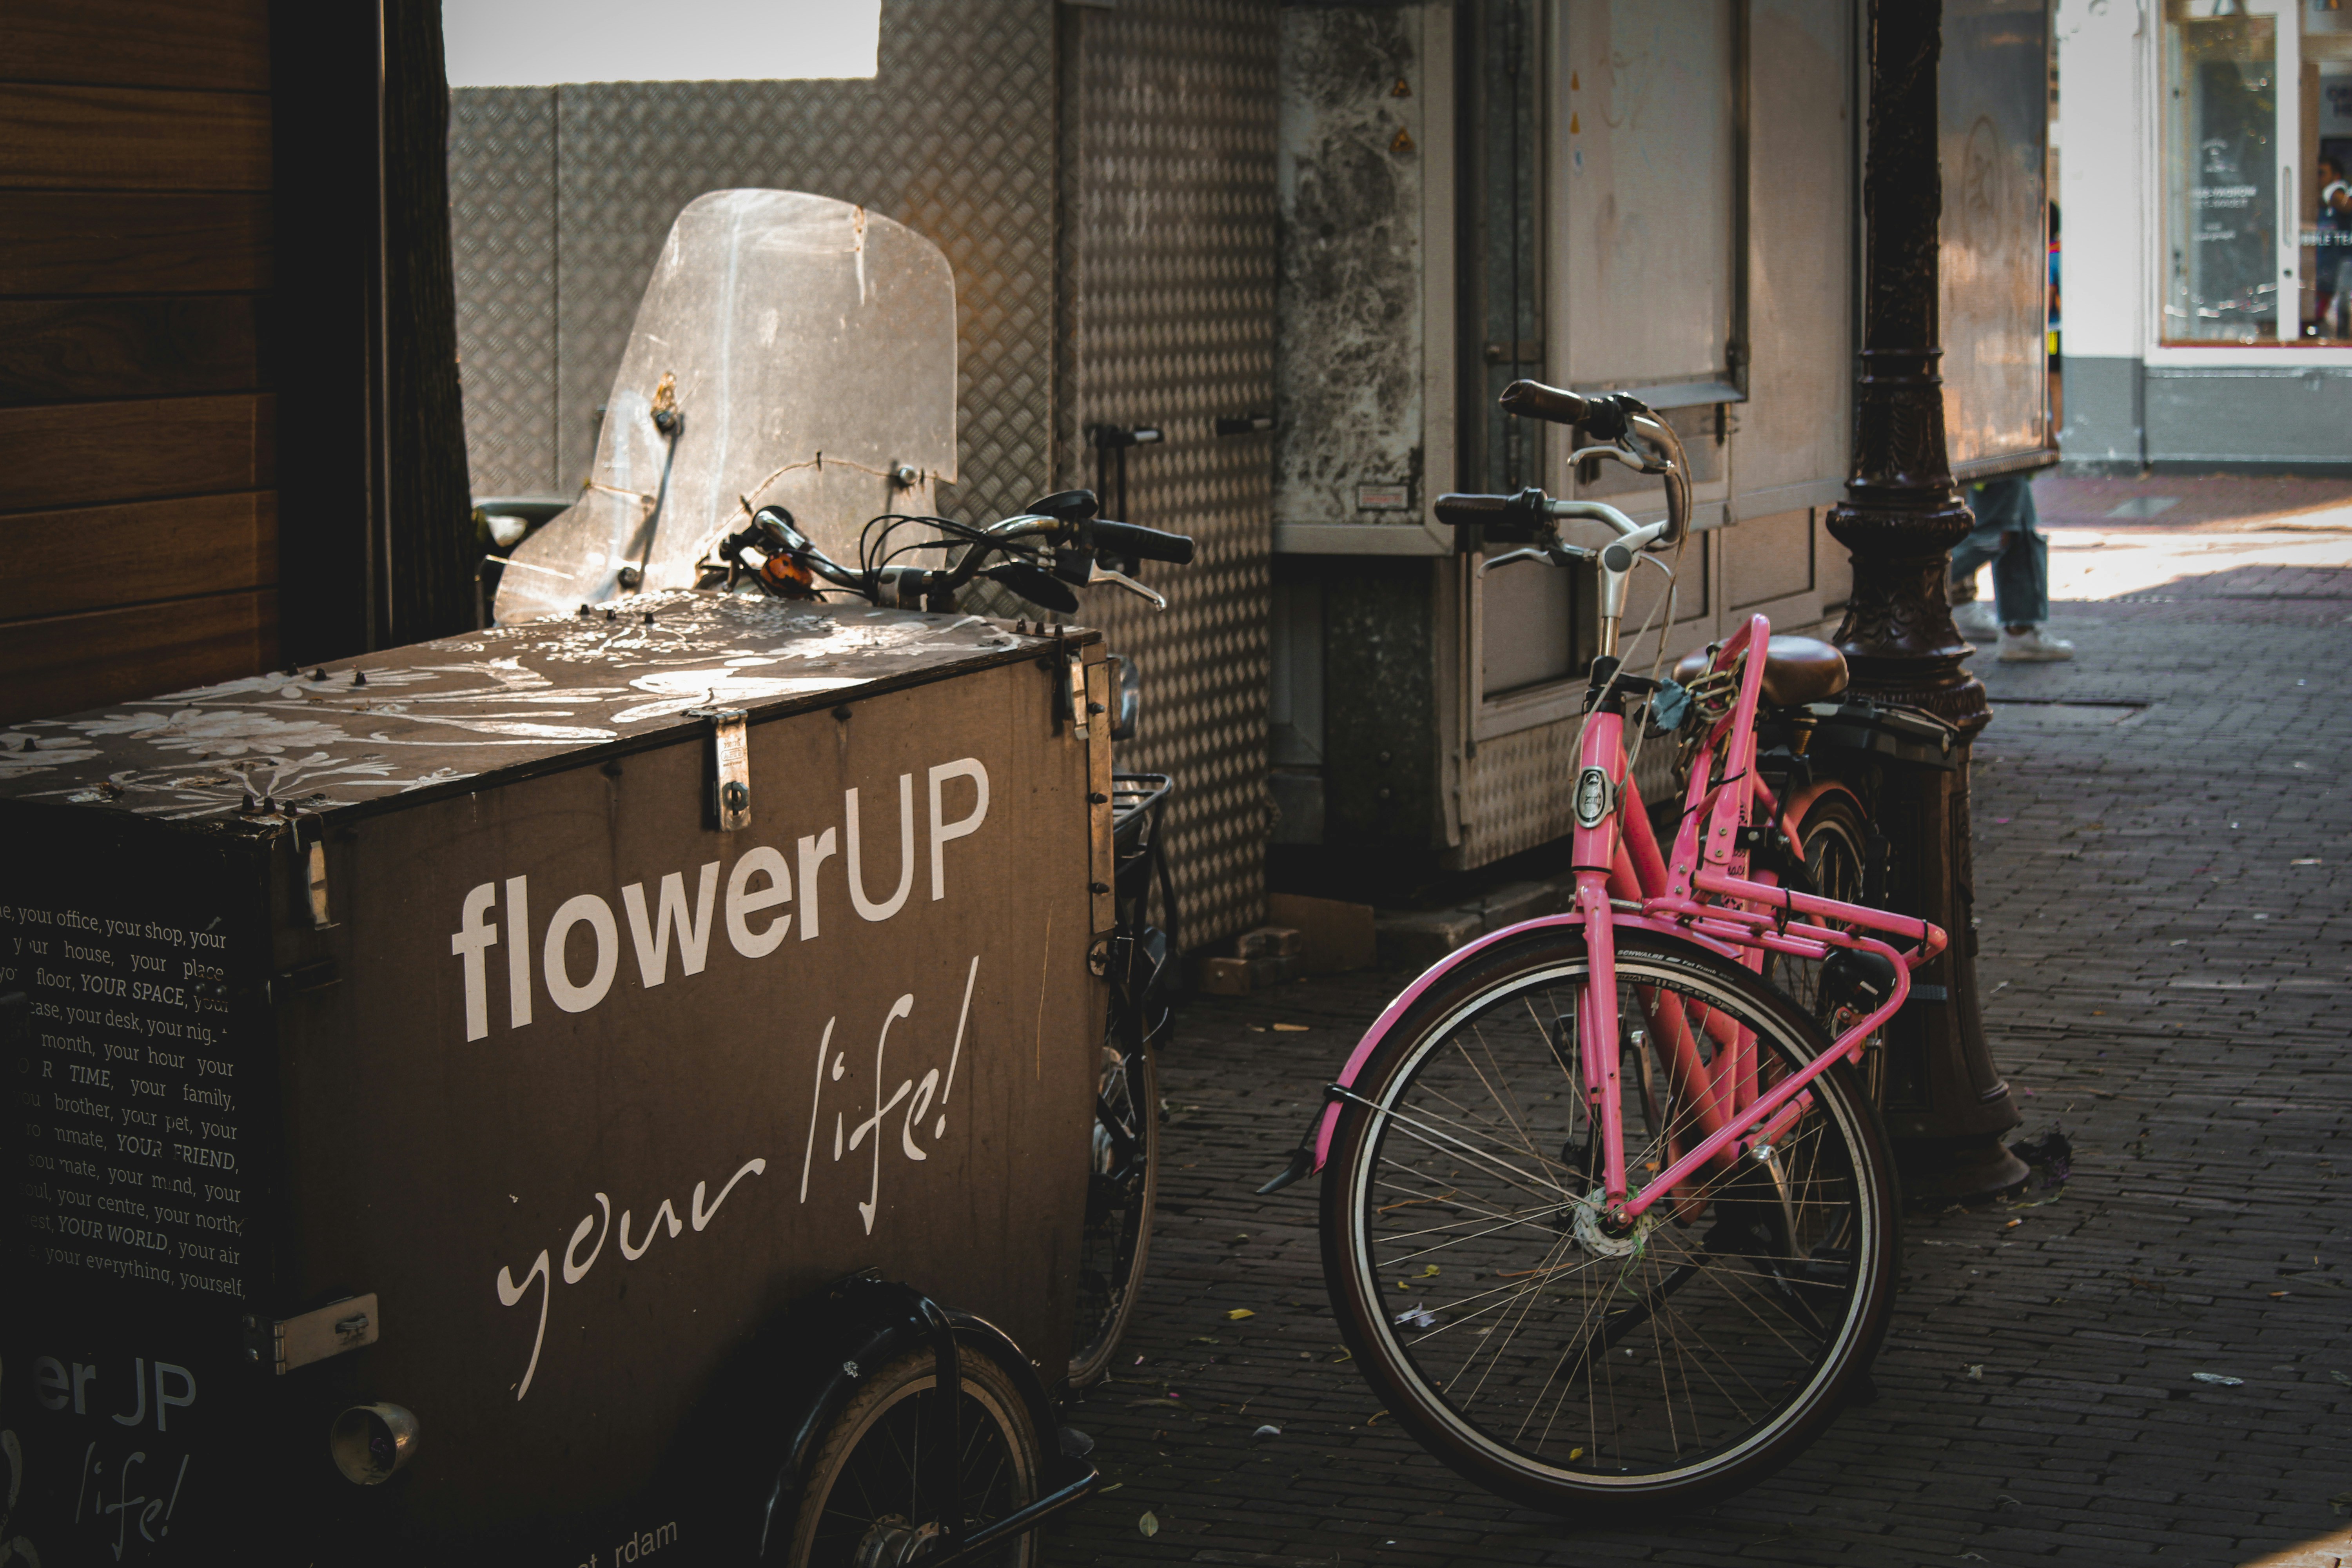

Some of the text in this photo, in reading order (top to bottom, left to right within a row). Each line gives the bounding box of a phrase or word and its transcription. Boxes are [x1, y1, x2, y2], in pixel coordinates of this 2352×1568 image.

[452, 757, 990, 1042] flowerUP
[18, 907, 52, 925] your
[56, 909, 102, 934] office,
[105, 919, 141, 937] your
[145, 921, 186, 947] shop,
[189, 931, 226, 949] your
[13, 937, 224, 981] yur house, your place
[1617, 949, 1664, 961] SCHWALBE
[36, 967, 75, 992] floor,
[80, 973, 127, 997] YOUR
[132, 981, 188, 1009] SPACE,
[193, 995, 229, 1013] your
[66, 1007, 102, 1024] your
[105, 1009, 143, 1034] desk,
[146, 1019, 183, 1037] your
[41, 1034, 234, 1077] month, your hour your
[69, 1064, 114, 1091] TIME,
[130, 1079, 166, 1096] your
[183, 1083, 235, 1112] family,
[13, 1091, 237, 1140] you brother, your pet, your
[116, 1134, 162, 1158] YOUR
[173, 1143, 238, 1174] FRIEND,
[107, 1167, 143, 1185] your
[151, 1175, 196, 1198] mind,
[204, 1184, 241, 1203] your
[497, 955, 979, 1401] your life!
[18, 1181, 242, 1237] soul, your centre, your north,
[58, 1215, 103, 1240] YOUR
[107, 1224, 171, 1255] WORLD,
[178, 1242, 215, 1260] your
[219, 1247, 240, 1265] air
[45, 1248, 80, 1265] your
[86, 1255, 174, 1286] everything,
[180, 1272, 245, 1300] yourself,
[75, 1441, 190, 1561] life!
